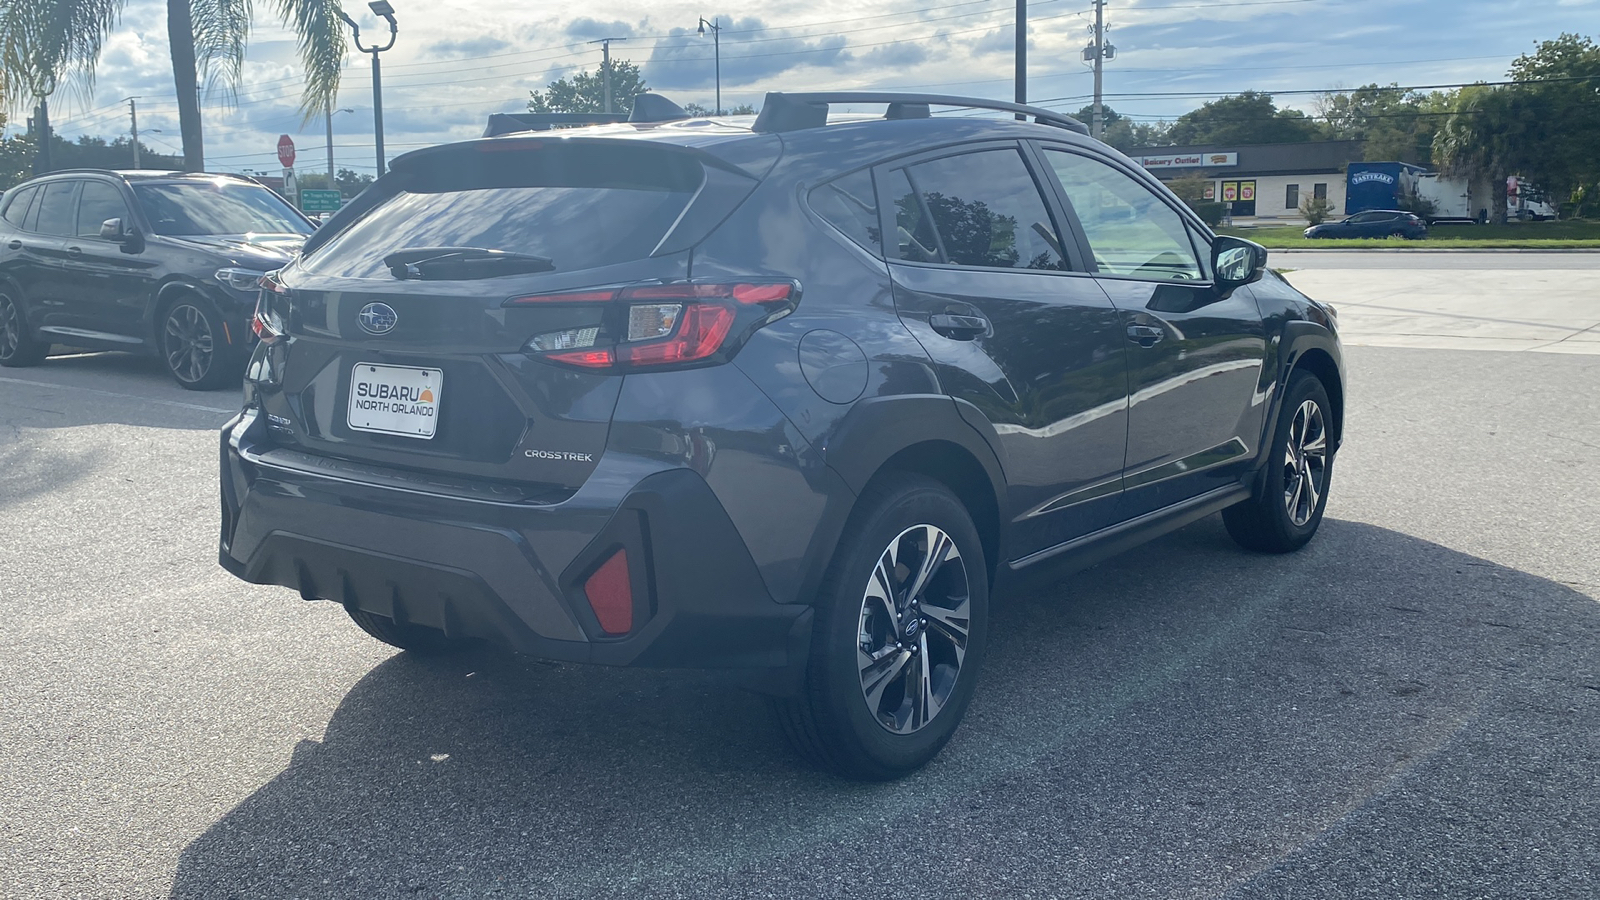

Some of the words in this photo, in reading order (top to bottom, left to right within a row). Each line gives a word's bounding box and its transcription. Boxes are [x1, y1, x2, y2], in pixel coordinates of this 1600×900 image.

[279, 145, 294, 158] STOP
[1144, 158, 1172, 166] Bakery
[357, 382, 420, 402] SUBARU
[356, 399, 390, 412] NORTH
[391, 403, 434, 417] ORLANDO
[524, 449, 593, 462] CROSSTREK
